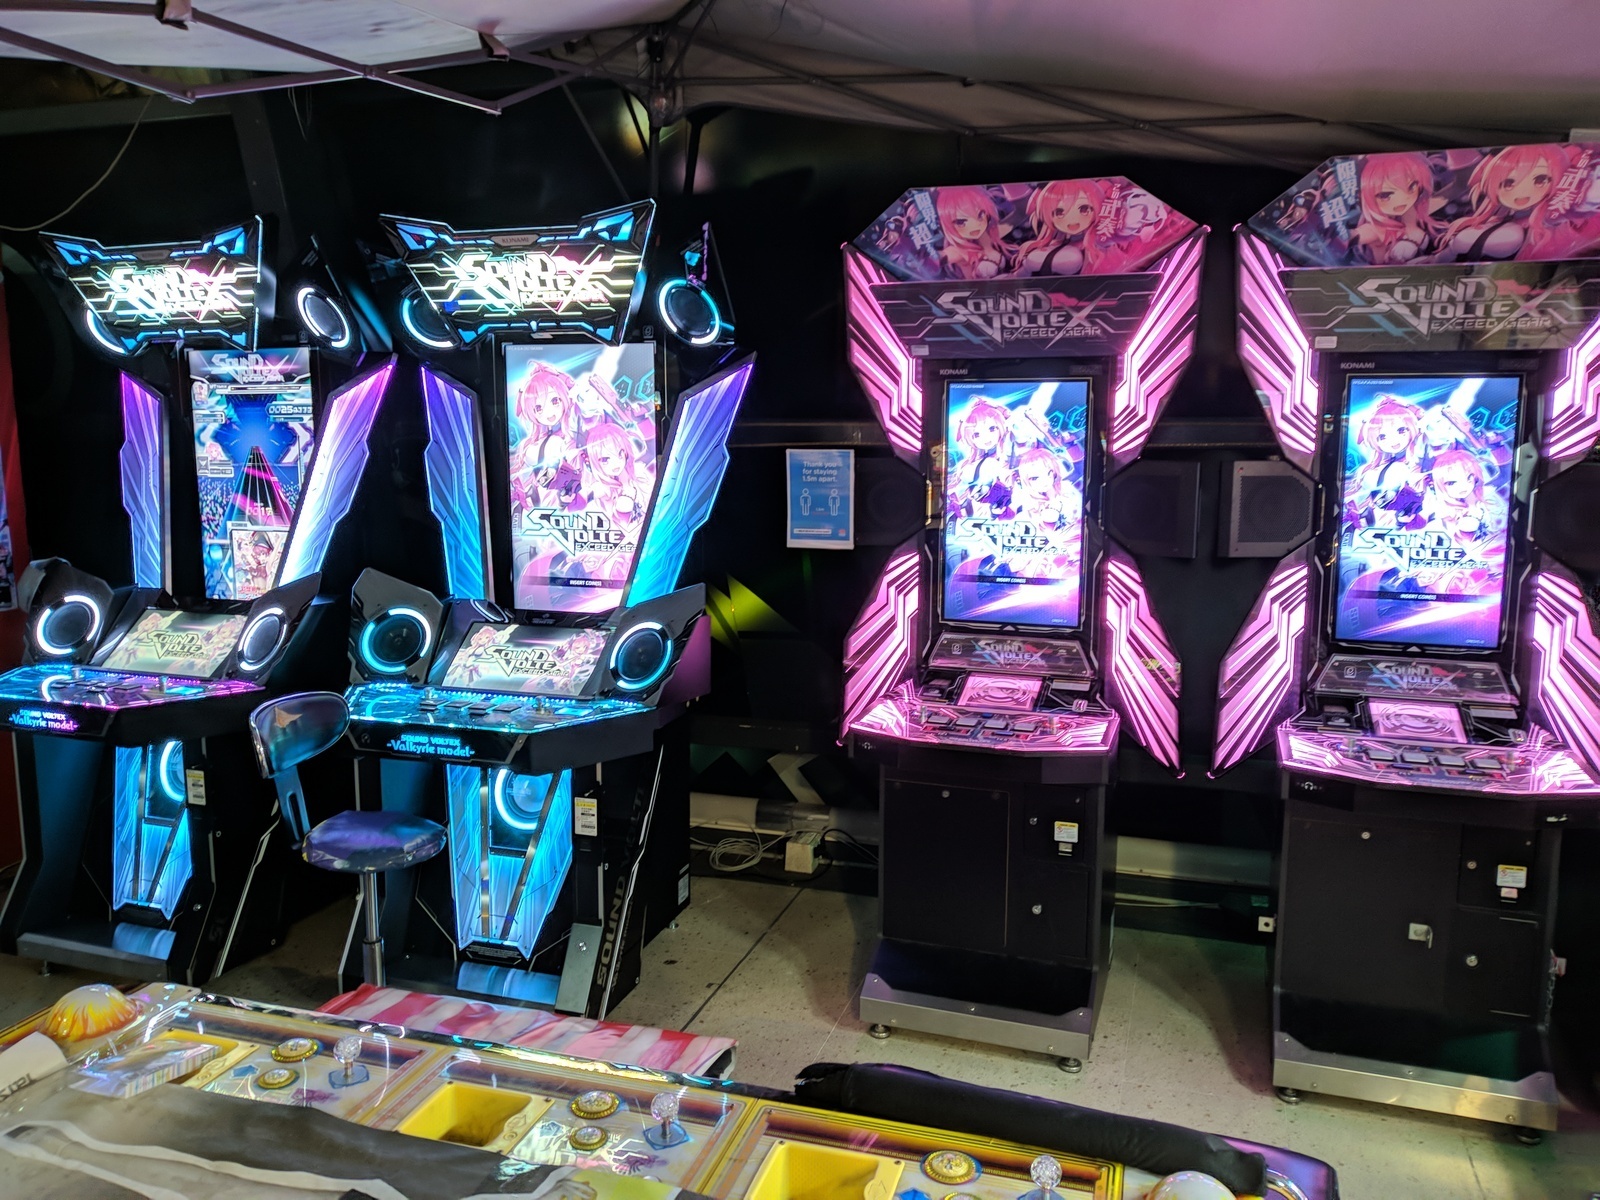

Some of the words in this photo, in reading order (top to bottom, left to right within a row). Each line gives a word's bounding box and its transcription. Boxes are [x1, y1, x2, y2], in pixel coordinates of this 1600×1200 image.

[931, 290, 1051, 324] SOUND
[1346, 277, 1497, 313] SOUND
[960, 295, 1105, 348] VOLTEX
[1389, 282, 1562, 343] VOLTEX
[1003, 326, 1057, 339] EXCEED
[1062, 326, 1102, 337] GEAR
[1431, 318, 1498, 332] EXCEED
[1504, 318, 1551, 329] GEAR
[521, 509, 611, 536] SOUND
[955, 518, 1038, 542] SOUND
[576, 543, 615, 552] EXCEED
[1351, 528, 1453, 553] SOUND
[137, 630, 201, 647] SOUND
[973, 640, 1025, 654] SOUND
[474, 645, 550, 663] SOUND
[1369, 662, 1433, 677] SOUND
[596, 875, 627, 987] SOUND
